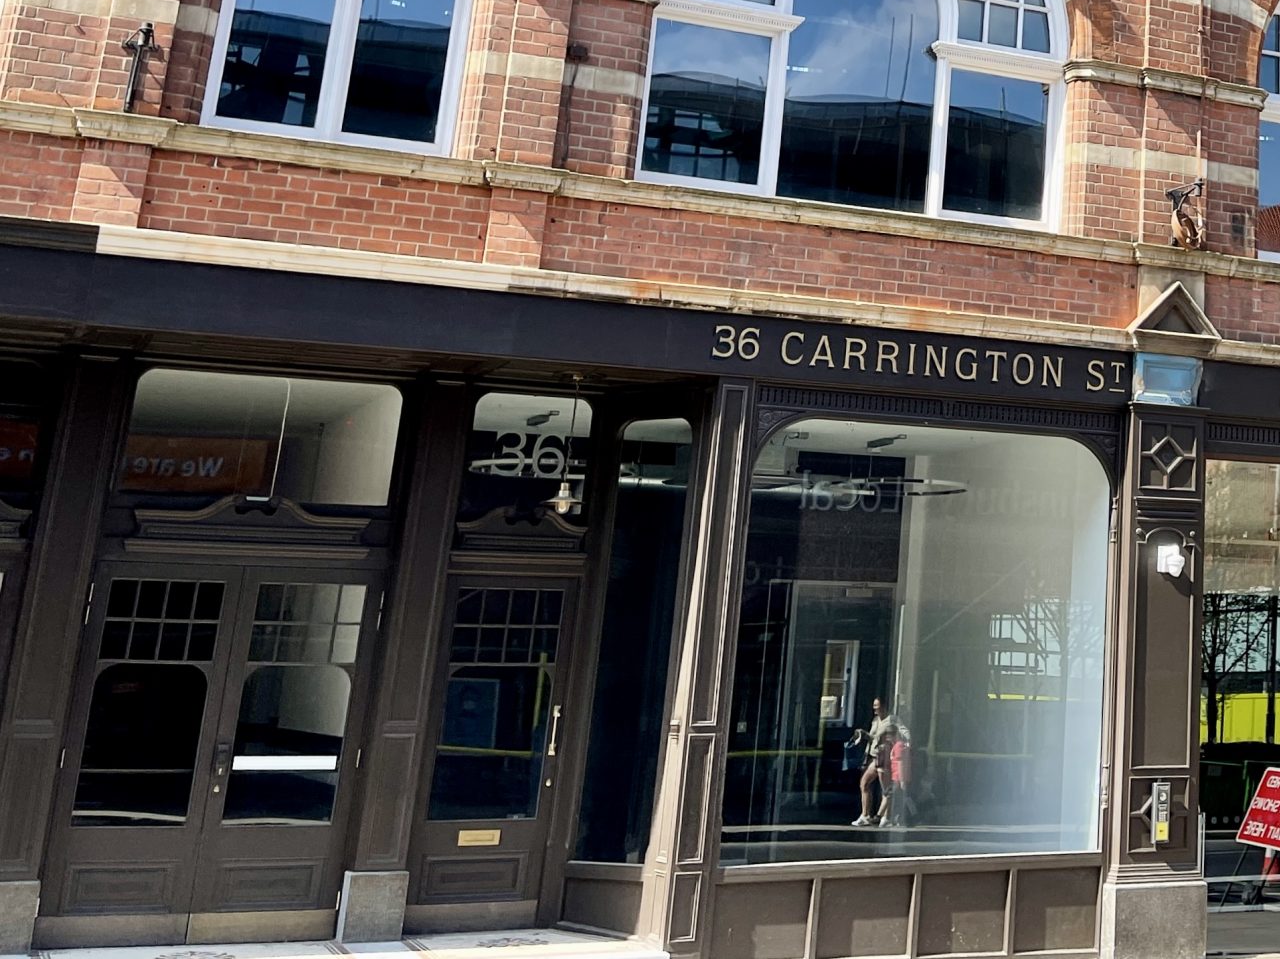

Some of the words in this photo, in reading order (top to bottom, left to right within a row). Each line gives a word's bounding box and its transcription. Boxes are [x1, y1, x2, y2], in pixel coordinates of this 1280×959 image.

[712, 325, 760, 360] 36
[781, 331, 1063, 387] CARRINGTON
[1086, 360, 1127, 392] ST
[490, 429, 566, 478] 36
